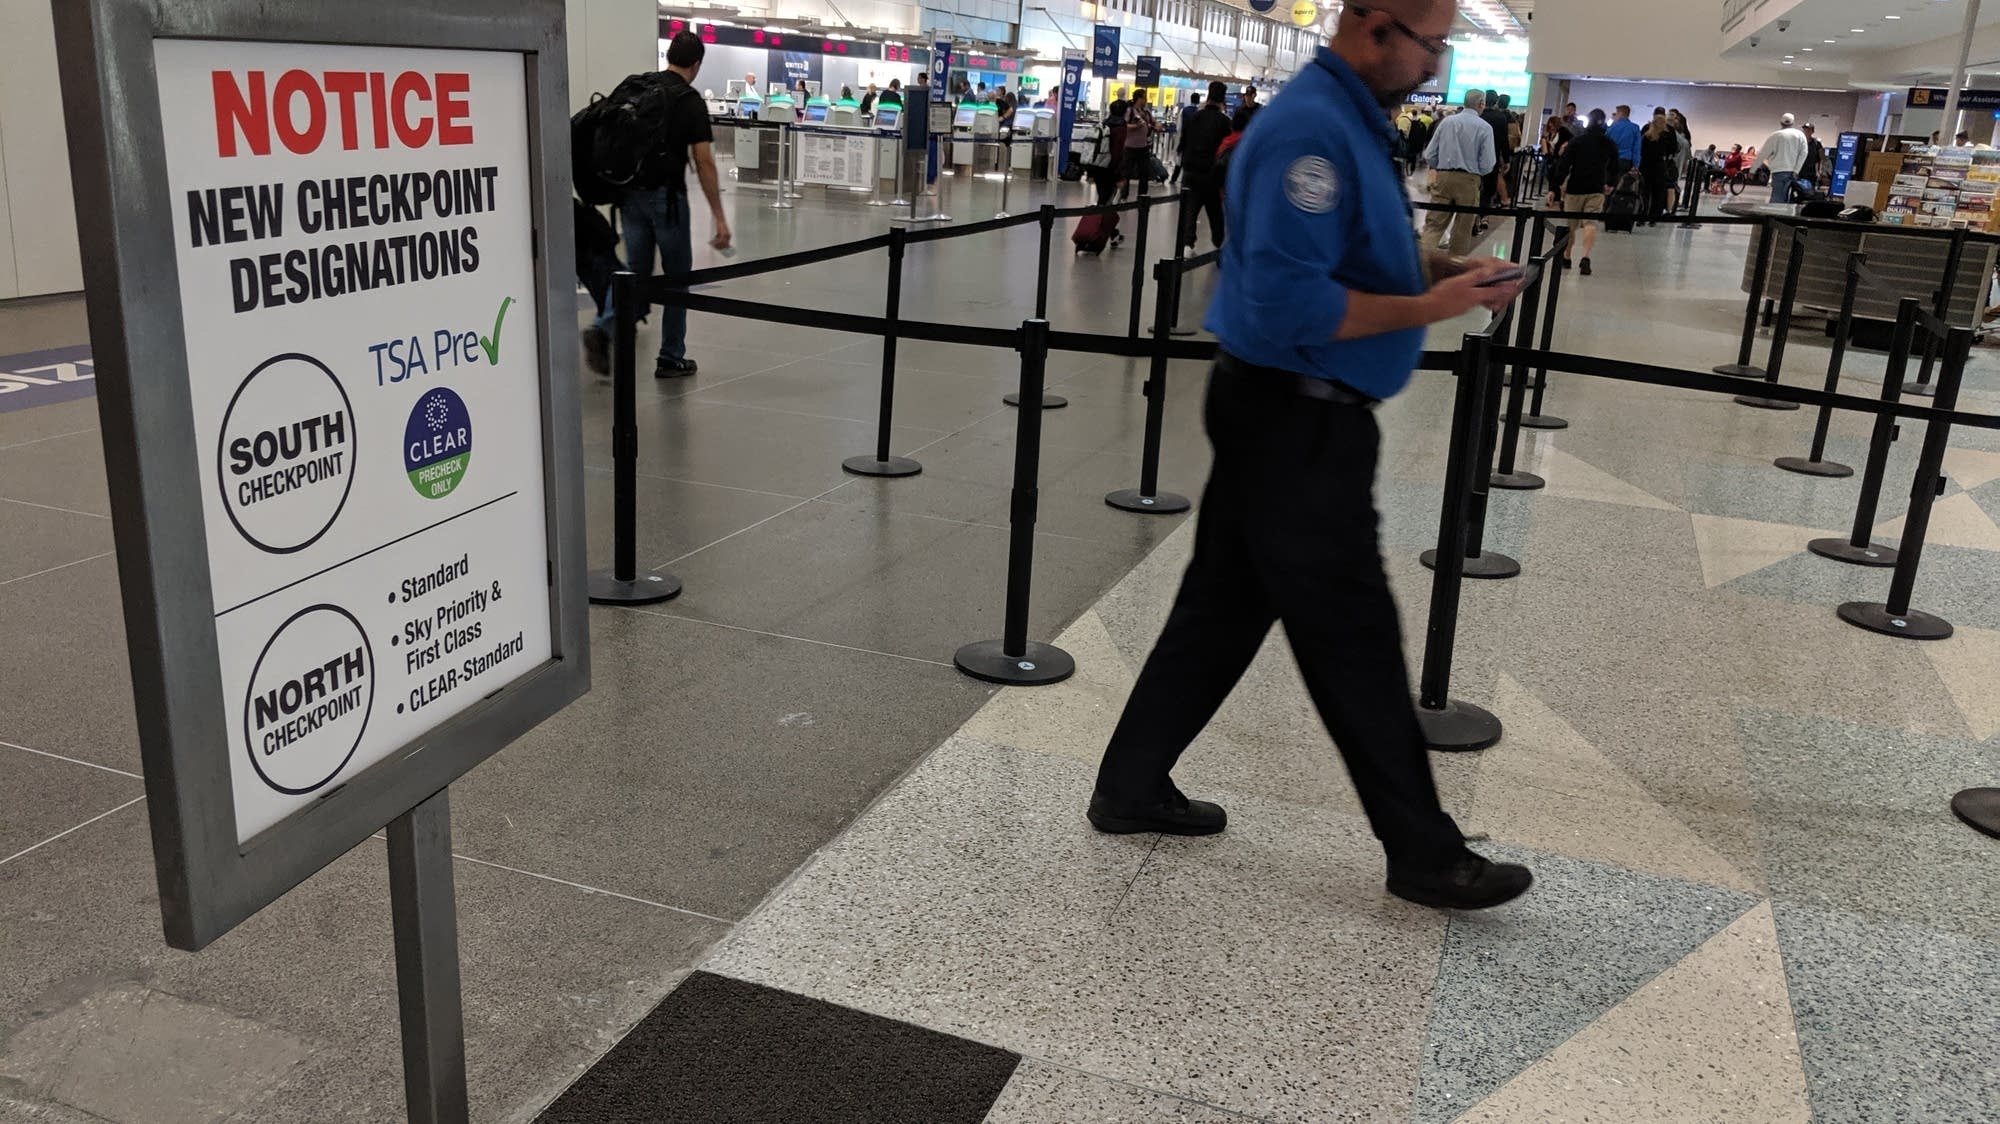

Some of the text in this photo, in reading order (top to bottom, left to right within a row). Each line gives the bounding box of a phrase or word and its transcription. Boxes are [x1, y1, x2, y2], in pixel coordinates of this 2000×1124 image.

[211, 69, 474, 158] NOTICE
[187, 166, 498, 248] NEW CHECKPOINT
[229, 226, 480, 314] DESIGNATIONS
[368, 335, 428, 386] TSA
[229, 410, 345, 476] SOUTH
[409, 427, 468, 463] CLEAR
[418, 457, 463, 486] PRECHECK
[238, 451, 344, 507] CHECKPOINT
[431, 477, 452, 497] ONLY
[401, 553, 470, 603] Standard
[404, 580, 503, 646] Sky Priority &
[406, 621, 483, 675] First Class
[409, 631, 524, 712] CLEAR-Standard
[254, 646, 366, 731] NORTH
[263, 684, 363, 757] CHECKPOINT
